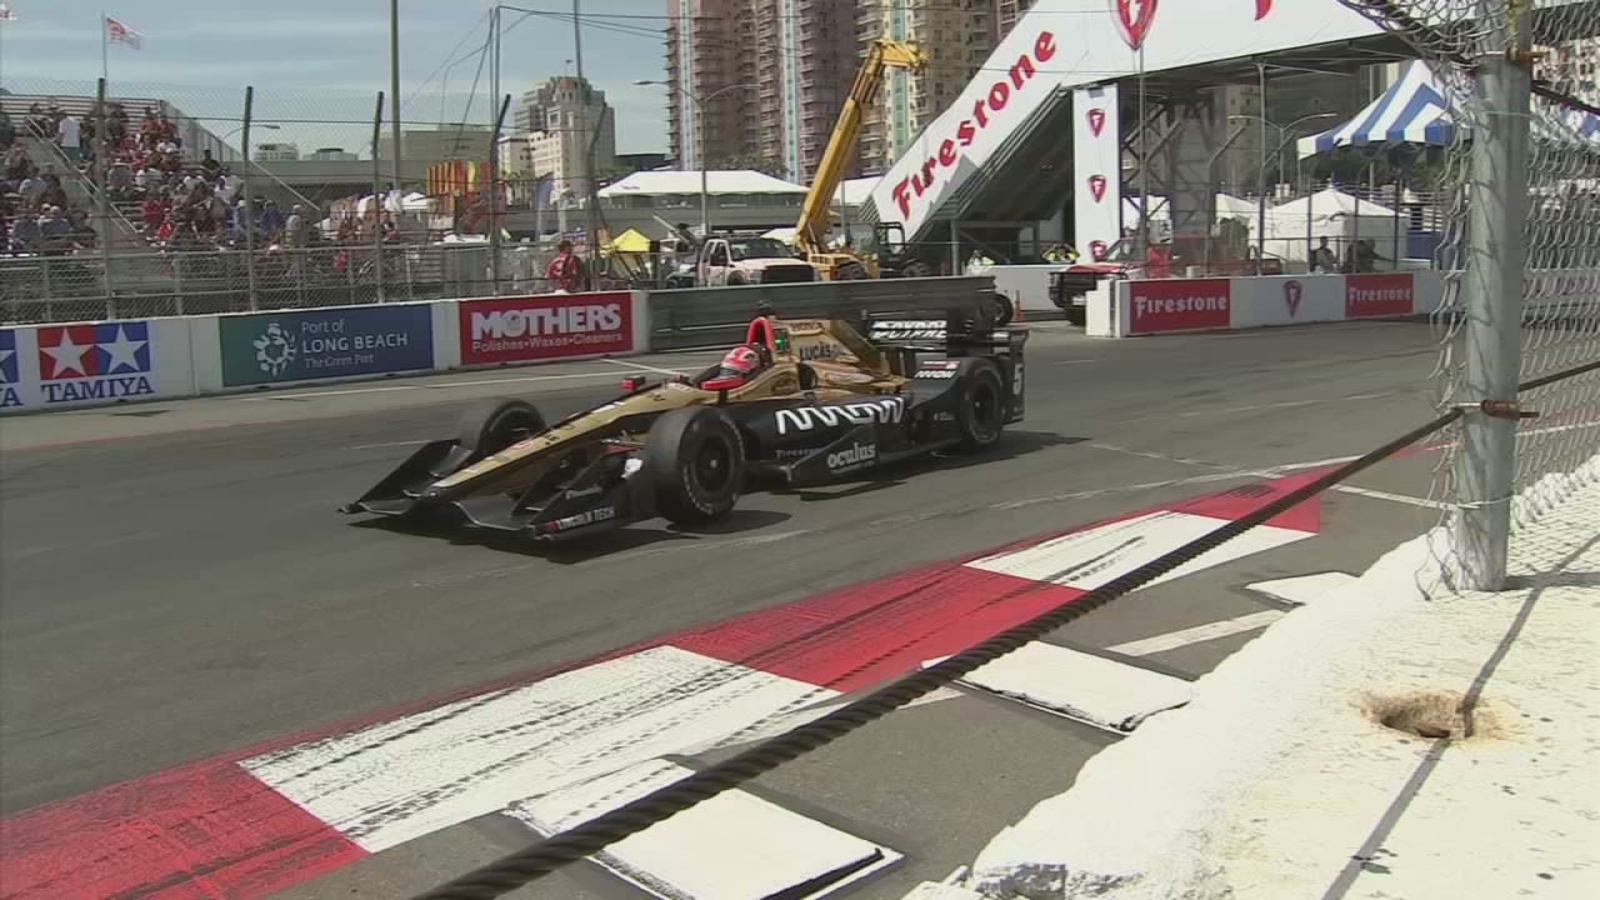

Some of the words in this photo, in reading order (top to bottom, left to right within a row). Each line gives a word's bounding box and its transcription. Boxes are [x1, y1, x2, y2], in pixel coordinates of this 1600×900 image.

[892, 31, 1056, 222] Firestone
[1348, 286, 1411, 305] Firestone
[1133, 296, 1228, 319] Firestone
[302, 321, 330, 334] Port
[331, 319, 345, 333] of
[471, 303, 621, 341] MOTHERS
[302, 337, 349, 354] LONG
[354, 332, 409, 350] BEACH
[0, 386, 25, 407] A
[40, 376, 155, 403] TAMIYA
[827, 441, 876, 469] oculus
